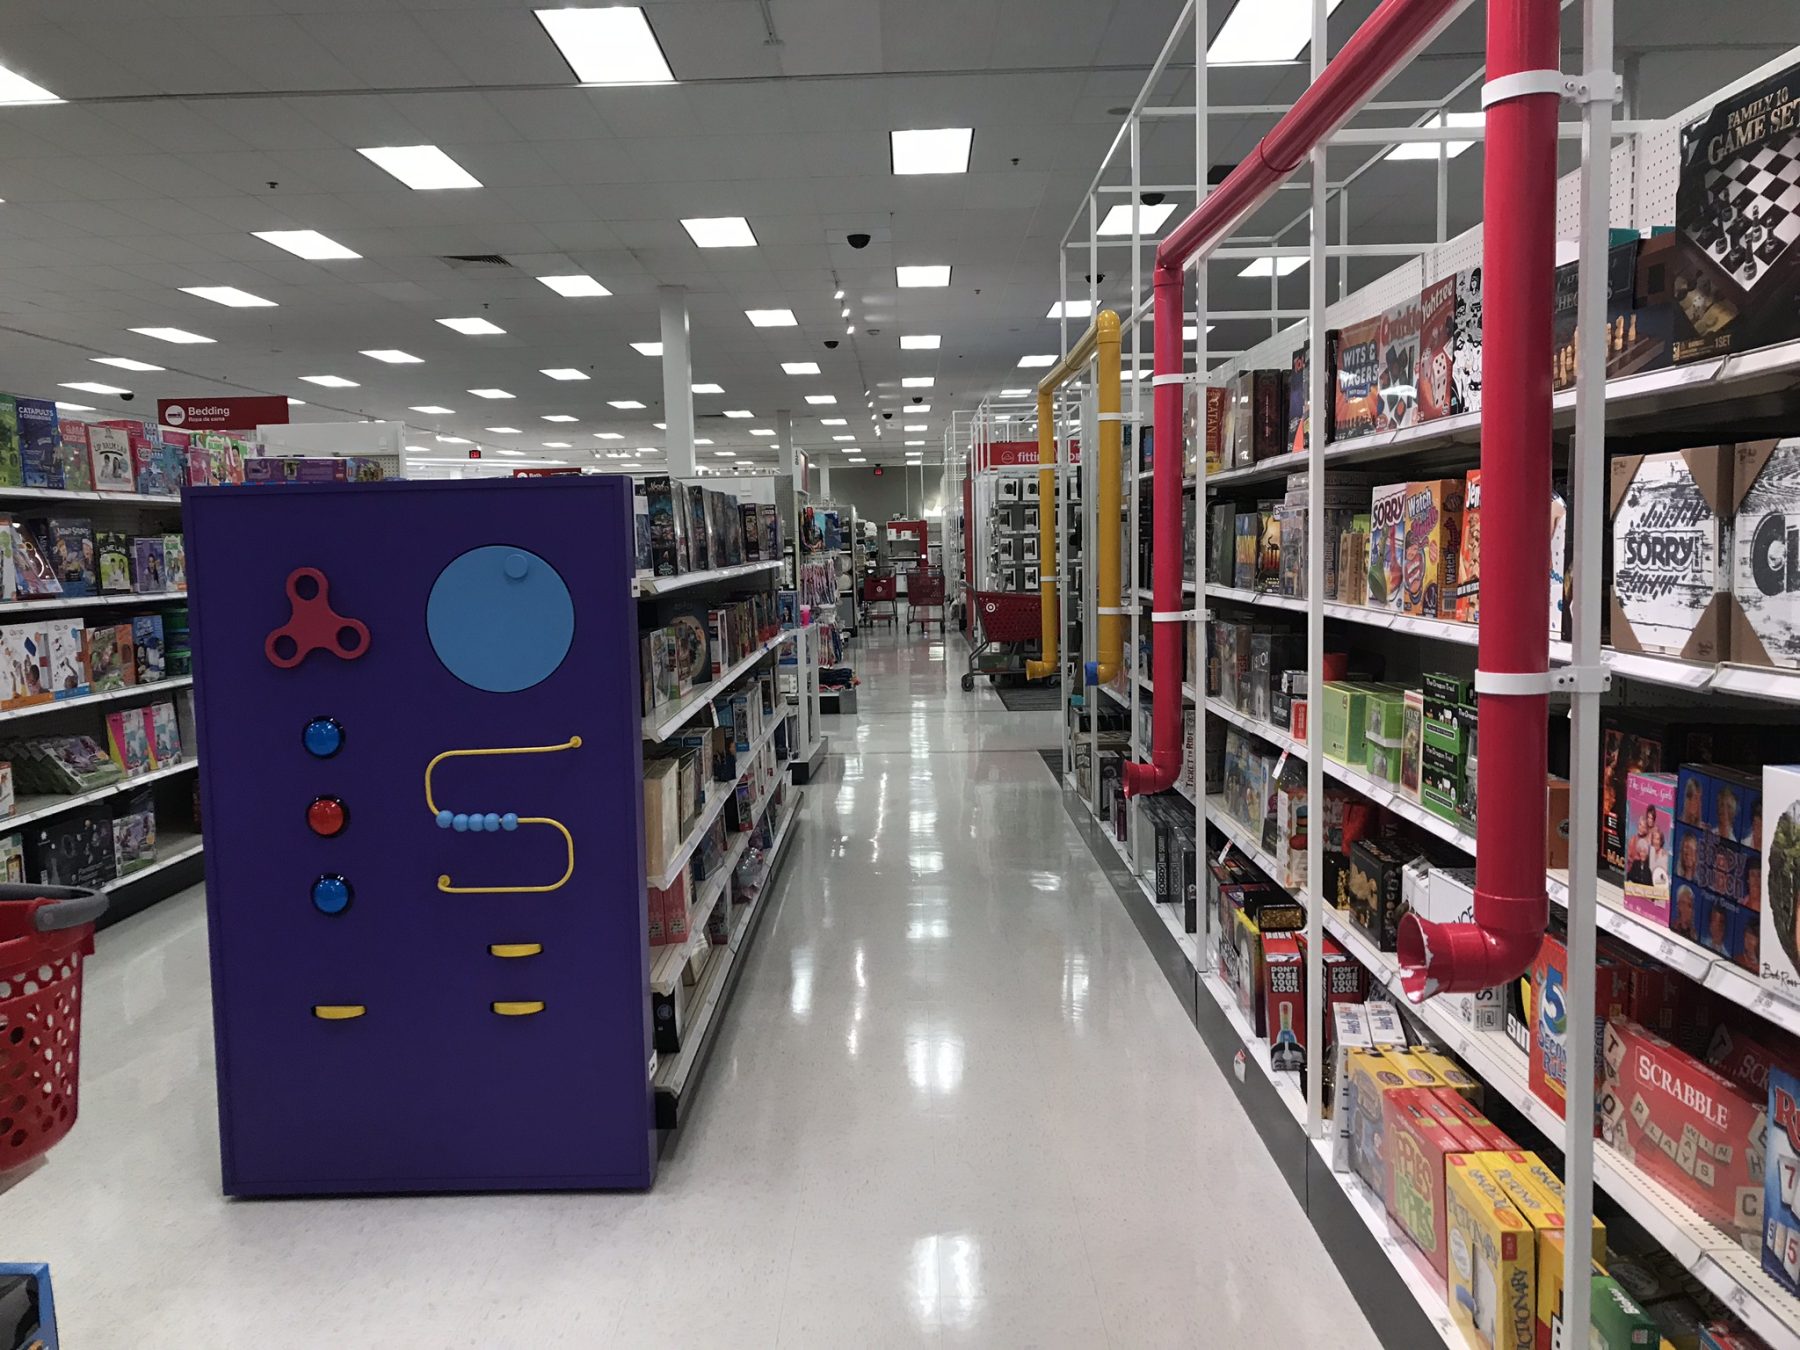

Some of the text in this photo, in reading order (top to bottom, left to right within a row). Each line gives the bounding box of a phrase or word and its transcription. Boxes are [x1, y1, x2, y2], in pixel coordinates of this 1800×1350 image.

[1727, 86, 1789, 130] FAMILY 10
[1708, 115, 1766, 166] GAME
[1422, 279, 1453, 323] Yahtzee
[1343, 346, 1367, 368] WITS
[1340, 363, 1379, 389] WAGERS
[18, 406, 54, 417] CATAPULTS
[188, 406, 230, 417] Bedding
[1207, 395, 1220, 433] CATAN
[1373, 494, 1405, 530] SORRY
[1407, 488, 1433, 516] Watch
[1446, 553, 1457, 585] Watch
[1271, 972, 1298, 980] LOSE
[1332, 972, 1358, 980] LOSE
[1332, 979, 1358, 987] YOUR
[1761, 962, 1780, 980] Bob
[1272, 985, 1299, 993] COOL
[1332, 985, 1359, 993] COOL
[1638, 1054, 1729, 1130] SCRABBLE
